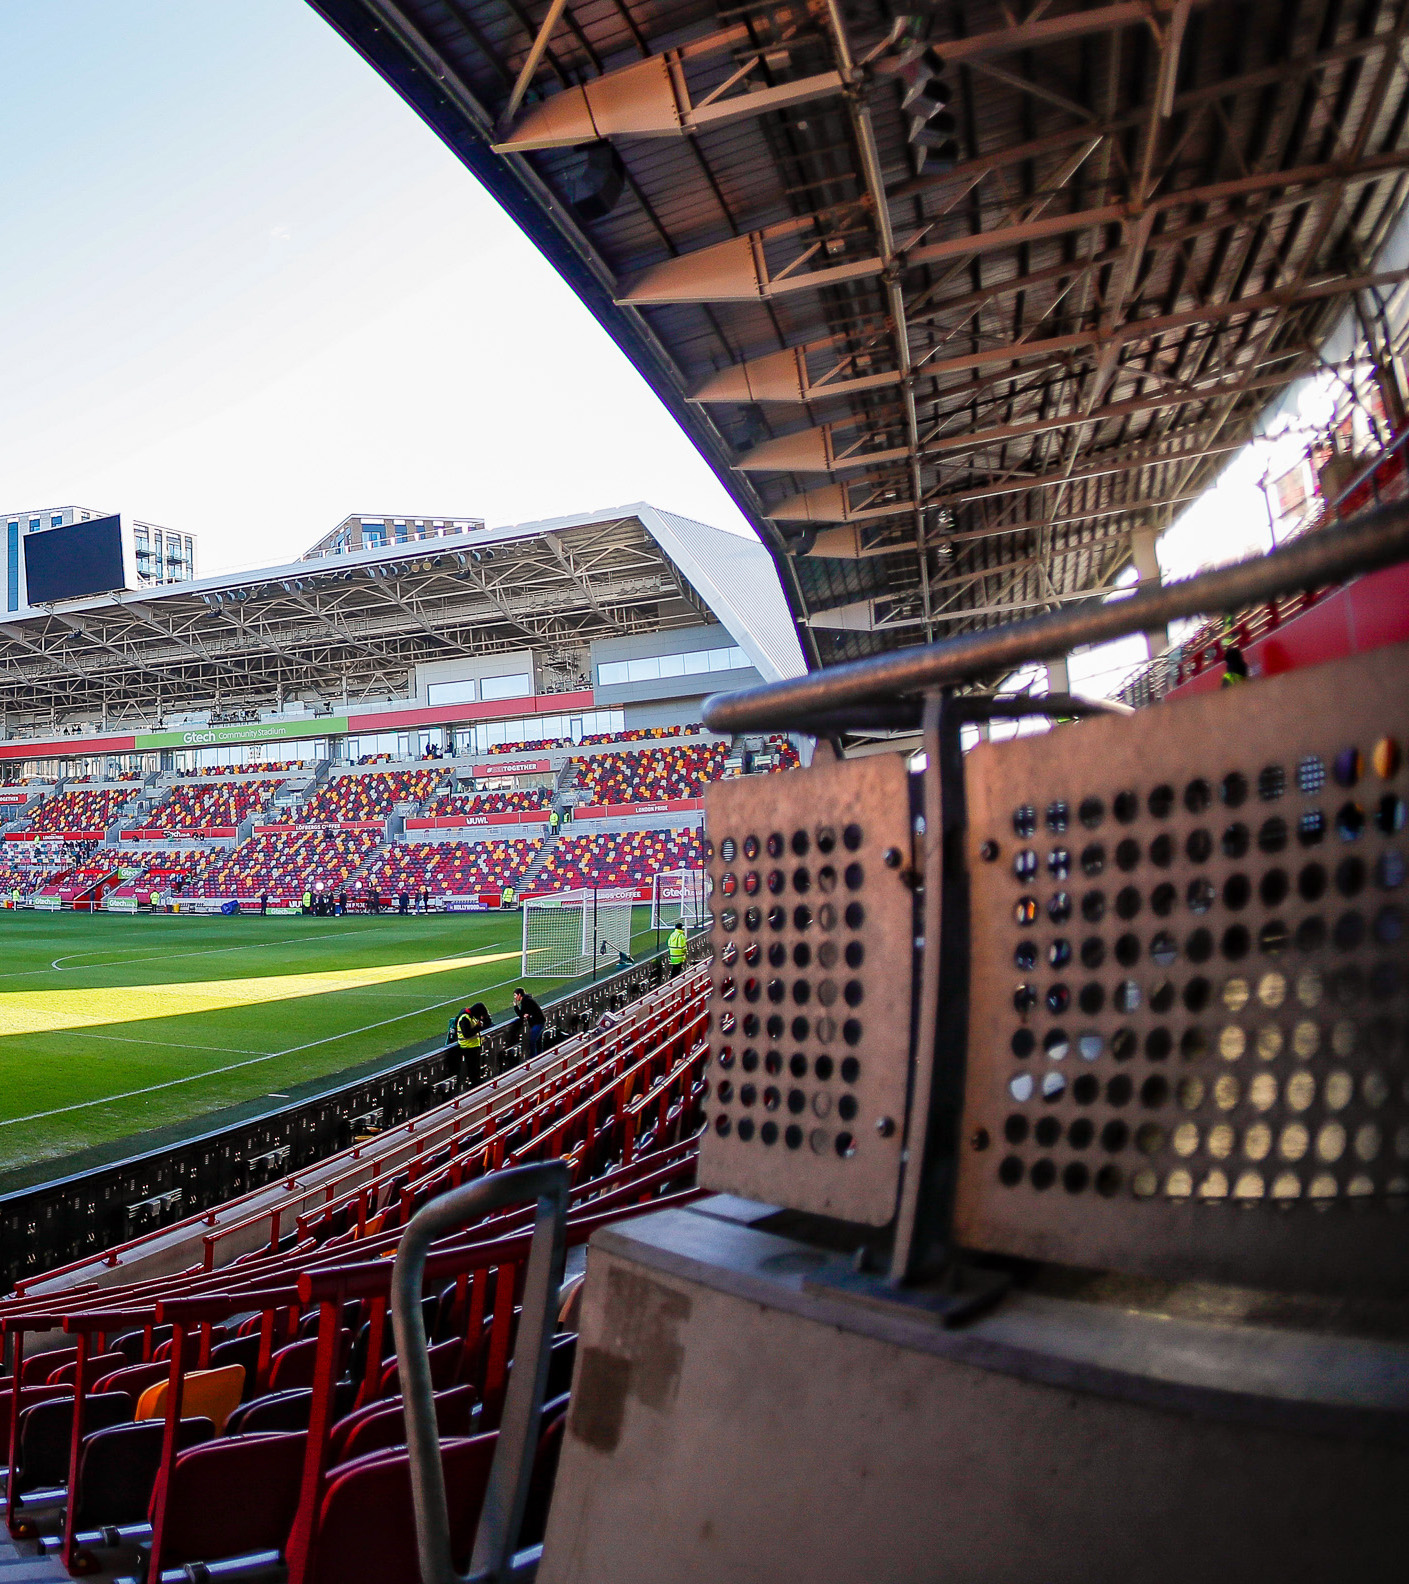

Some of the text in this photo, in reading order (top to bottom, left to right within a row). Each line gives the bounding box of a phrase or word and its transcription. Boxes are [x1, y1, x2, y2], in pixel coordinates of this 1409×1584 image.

[183, 727, 286, 744] Gtech Community Stadium
